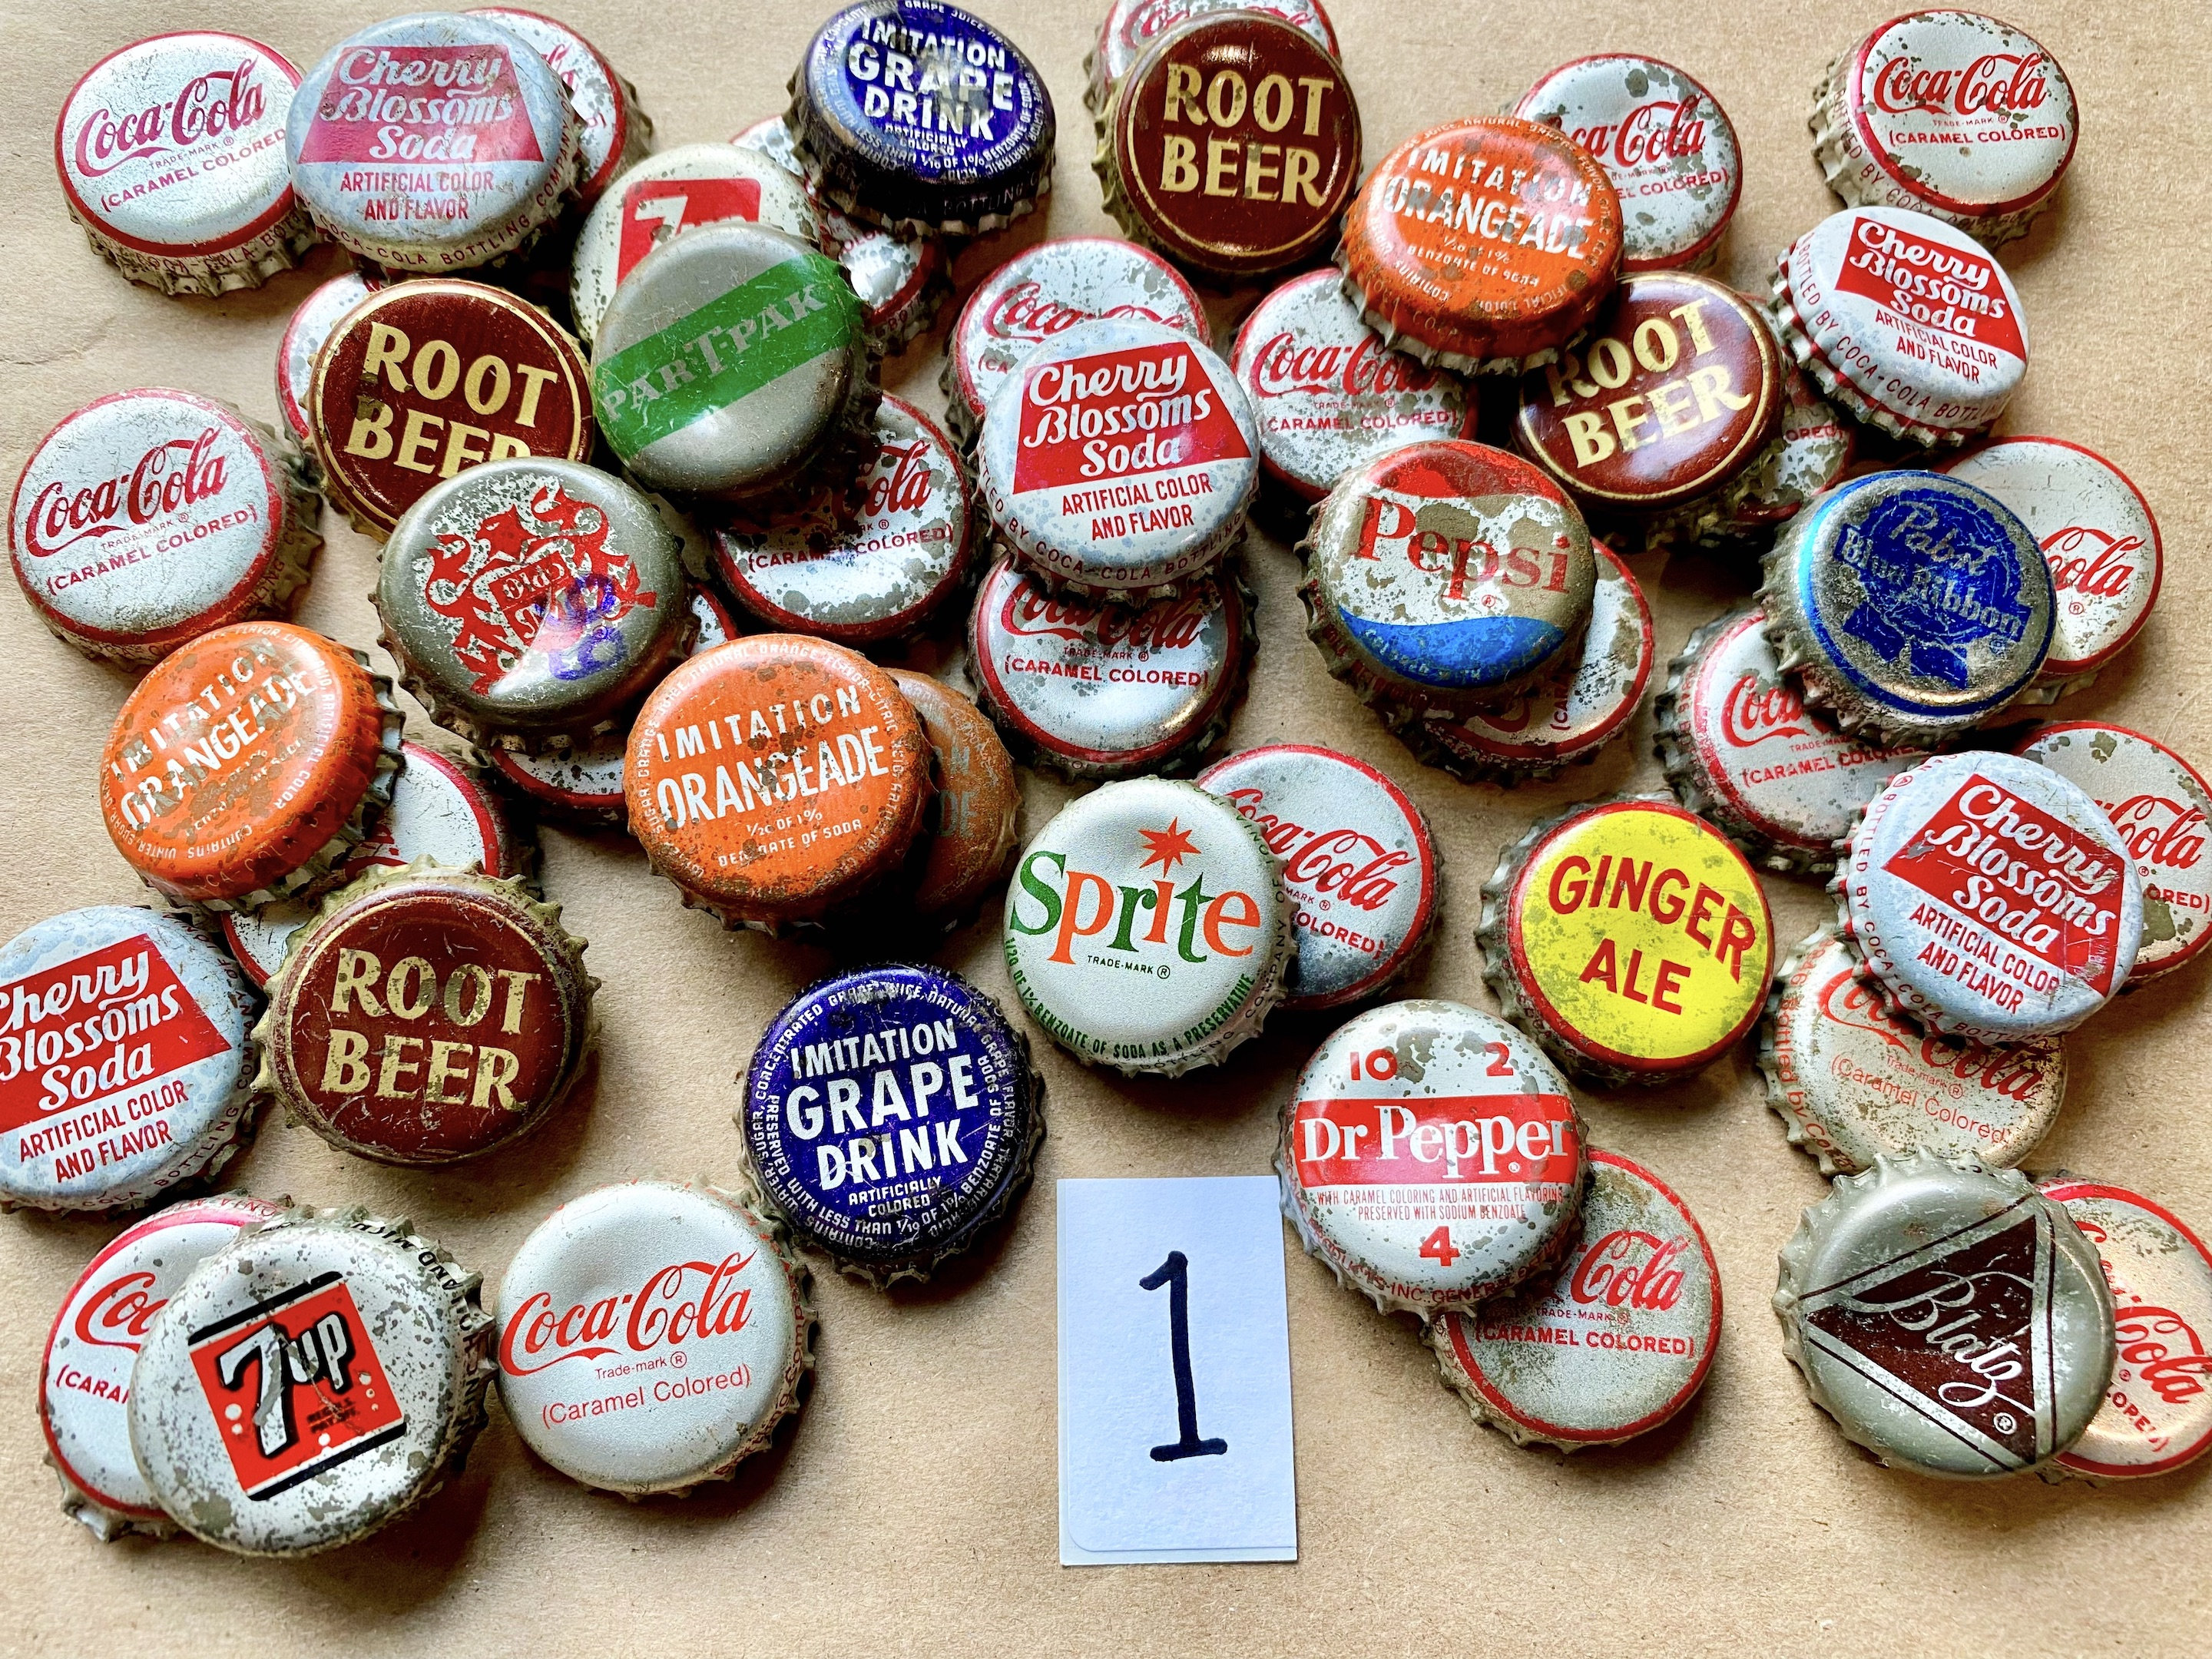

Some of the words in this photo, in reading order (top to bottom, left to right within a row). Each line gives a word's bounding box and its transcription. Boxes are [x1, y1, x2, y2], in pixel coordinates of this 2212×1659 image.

[338, 49, 502, 96] Cherry
[849, 42, 1015, 111] GRAPE
[862, 18, 1005, 71] IMITATION
[75, 55, 267, 177] Coca-Cola
[319, 86, 514, 125] Blossoms
[864, 84, 995, 141] DRINK
[1164, 61, 1335, 138] ROOT
[1873, 52, 2047, 116] Coca-Cola
[369, 125, 478, 160] Soda
[1889, 129, 1974, 147] (CARAMEL
[1977, 123, 2066, 144] COLORED)
[101, 165, 199, 213] (CARAMEL
[339, 171, 435, 193] ARTIFICIAL
[438, 171, 494, 192] COLOR
[1158, 134, 1329, 208] BEER
[1408, 148, 1593, 214] IMITATION
[1861, 162, 1885, 186] BY
[320, 214, 429, 265] COCA-COLA
[440, 215, 531, 266] BOTTLING
[364, 199, 400, 221] AND
[404, 197, 469, 220] FLAVOR
[1383, 174, 1596, 260] ORANGEADE
[1849, 250, 2006, 320] Blossoms
[1856, 221, 1992, 291] Cherry
[1796, 240, 1822, 306] BOTTLED
[1815, 310, 1839, 333] BY
[1836, 336, 1932, 411] COCA-COLA
[1875, 309, 1950, 353] ARTIFICIAL
[1950, 339, 1998, 370] COLOR
[1889, 289, 1977, 338] Soda
[359, 320, 558, 429] ROOT
[1028, 353, 1188, 407] Cherry
[1545, 296, 1719, 408] ROOT
[1896, 336, 1926, 361] AND
[1929, 350, 1981, 384] FLAVOR
[1022, 387, 1212, 449] Blossoms
[1561, 364, 1753, 469] BEER
[1079, 432, 1184, 478] Soda
[25, 426, 230, 558] Coca-Cola
[1061, 483, 1154, 516] ARTIFICIAL
[1157, 471, 1214, 501] COLOR
[1091, 516, 1127, 541] AND
[1128, 503, 1194, 535] FLAVOR
[47, 548, 152, 596] (CARAMEL
[157, 504, 258, 554] COLORED)
[1008, 518, 1029, 540] BY
[1035, 541, 1151, 582] COCA-COLA
[1349, 495, 1571, 601] Pepsi
[1891, 496, 2000, 575] Pabst
[1912, 572, 2022, 639] Ribbon
[1004, 654, 1103, 682] (CARAMEL
[1108, 667, 1209, 688] COLORED)
[109, 637, 277, 782] IMITATION
[656, 684, 862, 763] IMITATION
[119, 668, 318, 832] ORANGEADE
[657, 725, 889, 833] ORANGEADE
[1742, 756, 1836, 788] (CARAMEL
[776, 817, 793, 831] OF
[796, 808, 823, 827] 1%
[823, 819, 863, 839] SODA
[1856, 792, 1898, 873] BOTTLED
[1959, 784, 2120, 895] Cherry
[1009, 850, 1261, 965] Sprite
[1855, 884, 1870, 910] BY
[1924, 818, 2118, 937] Blossoms
[1548, 854, 1757, 985] GINGER
[1952, 874, 2061, 955] Soda
[1086, 955, 1154, 975] TRADE-MARK
[1578, 938, 1691, 1015] ALE
[1864, 920, 1945, 1021] COCA-COLA
[1908, 902, 2000, 968] ARTIFICIAL
[2002, 952, 2060, 995] COLOR
[1916, 942, 1955, 978] AND
[1959, 961, 2025, 1016] FLAVOR
[329, 947, 541, 1035] ROOT
[1012, 968, 1027, 988] OF
[1032, 1002, 1090, 1051] BENZOATE
[1092, 1041, 1108, 1056] OF
[1113, 1042, 1146, 1060] SODA
[1151, 1041, 1169, 1056] AS
[1173, 1038, 1182, 1052] A
[1184, 972, 1257, 1045] PRESERVATIVE
[38, 1042, 155, 1111] Soda
[320, 1028, 527, 1113] BEER
[755, 1003, 825, 1101] CONCENTRATED
[790, 1017, 959, 1081] IMITATION
[976, 1055, 999, 1094] SODA
[1349, 1048, 1399, 1081] 10
[1483, 1041, 1515, 1077] 2
[20, 1104, 126, 1163] ARTIFICIAL
[127, 1078, 190, 1121] COLOR
[785, 1053, 979, 1141] GRAPE
[989, 1097, 1003, 1118] OF
[55, 1147, 96, 1184] AND
[97, 1119, 173, 1166] FLAVOR
[154, 1105, 239, 1187] BOTTLING
[767, 1093, 790, 1177] PRESERVED
[816, 1118, 969, 1191] DRINK
[960, 1121, 1002, 1195] BENZOATE
[1300, 1117, 1368, 1163] Dr
[1374, 1104, 1575, 1179] Pepper
[786, 1177, 817, 1210] WITH
[816, 1204, 852, 1231] LESS
[848, 1176, 943, 1207] ARTIFICIALLY
[867, 1197, 932, 1218] COLORED
[921, 1210, 939, 1227] OF
[1343, 1189, 1387, 1204] CARAMEL
[1389, 1188, 1435, 1204] COLORING
[1439, 1188, 1459, 1204] AND
[1461, 1187, 1511, 1204] ARTIFICIAL
[1358, 1204, 1411, 1221] PRESERVED
[1413, 1205, 1436, 1220] WITH
[1439, 1205, 1476, 1220] SODIUM
[1479, 1204, 1527, 1220] BENZOATE
[853, 1219, 892, 1235] THAN
[1419, 1225, 1460, 1267] 4
[498, 1247, 758, 1377] Coca-Cola
[1475, 1323, 1581, 1346] (CARAMEL
[1585, 1331, 1695, 1359] COLORED)
[1843, 1270, 2036, 1418] Blatz
[594, 1355, 667, 1381] Trade-mark
[1138, 1250, 1228, 1462] 1
[542, 1386, 644, 1430] (Caramel
[653, 1362, 752, 1402] Colored)
